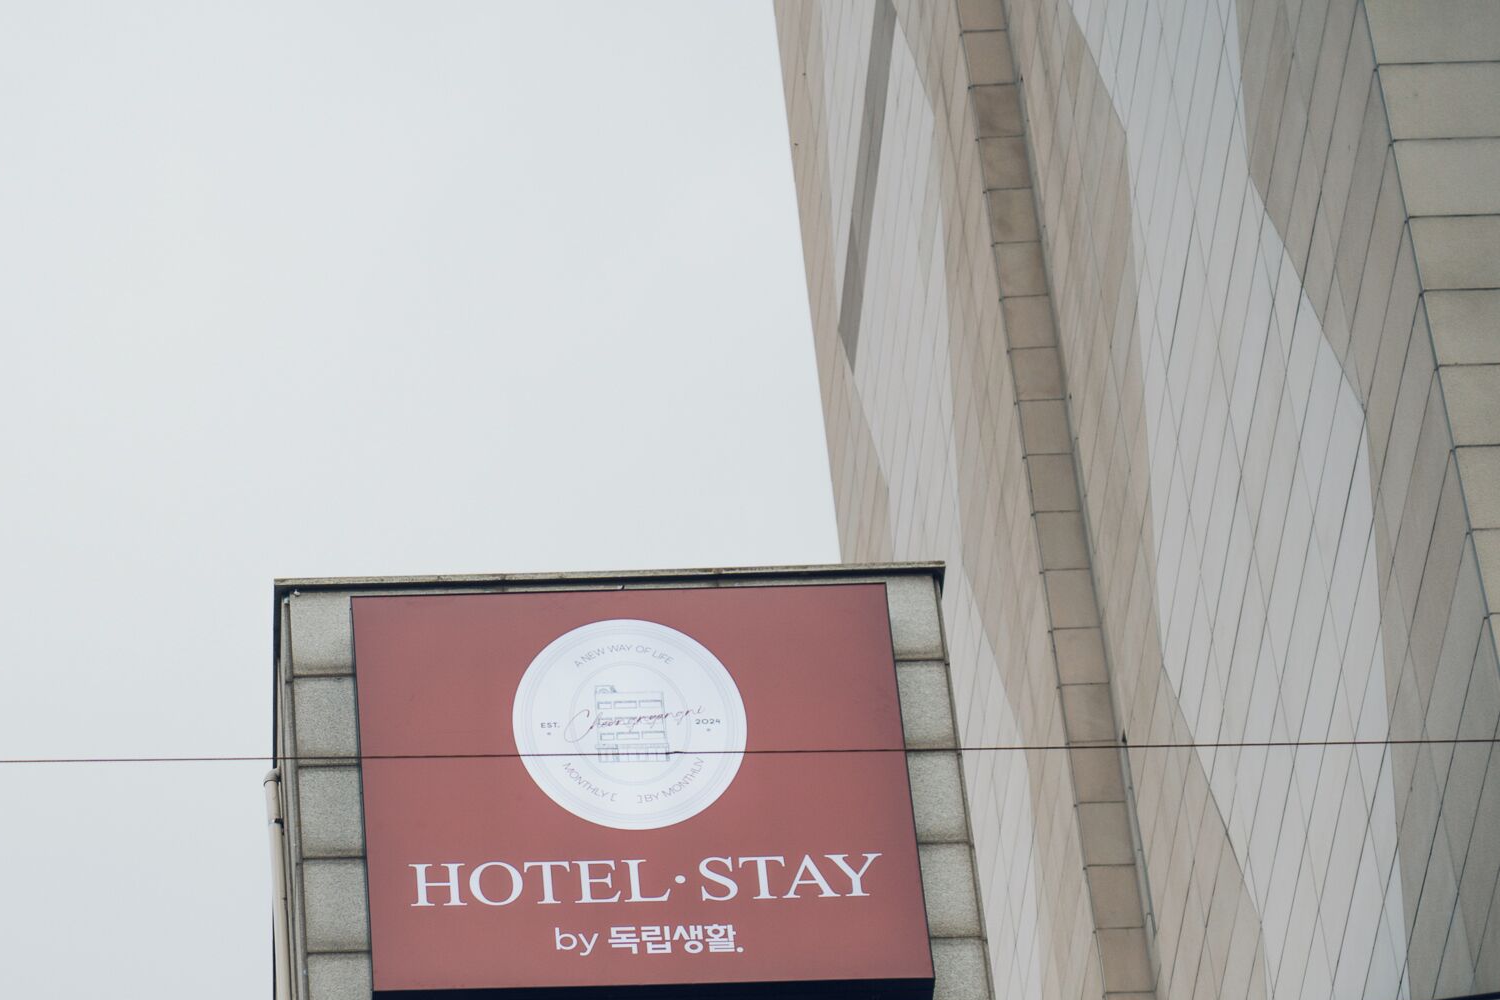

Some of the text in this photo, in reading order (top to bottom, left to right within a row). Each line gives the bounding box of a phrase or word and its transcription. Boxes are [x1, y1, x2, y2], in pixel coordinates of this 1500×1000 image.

[580, 648, 605, 663] NEW
[607, 644, 633, 653] WAY
[635, 645, 651, 654] OF
[652, 650, 674, 664] LIFE
[563, 762, 609, 798] MONTHLY
[554, 924, 744, 956] by 독립생활.
